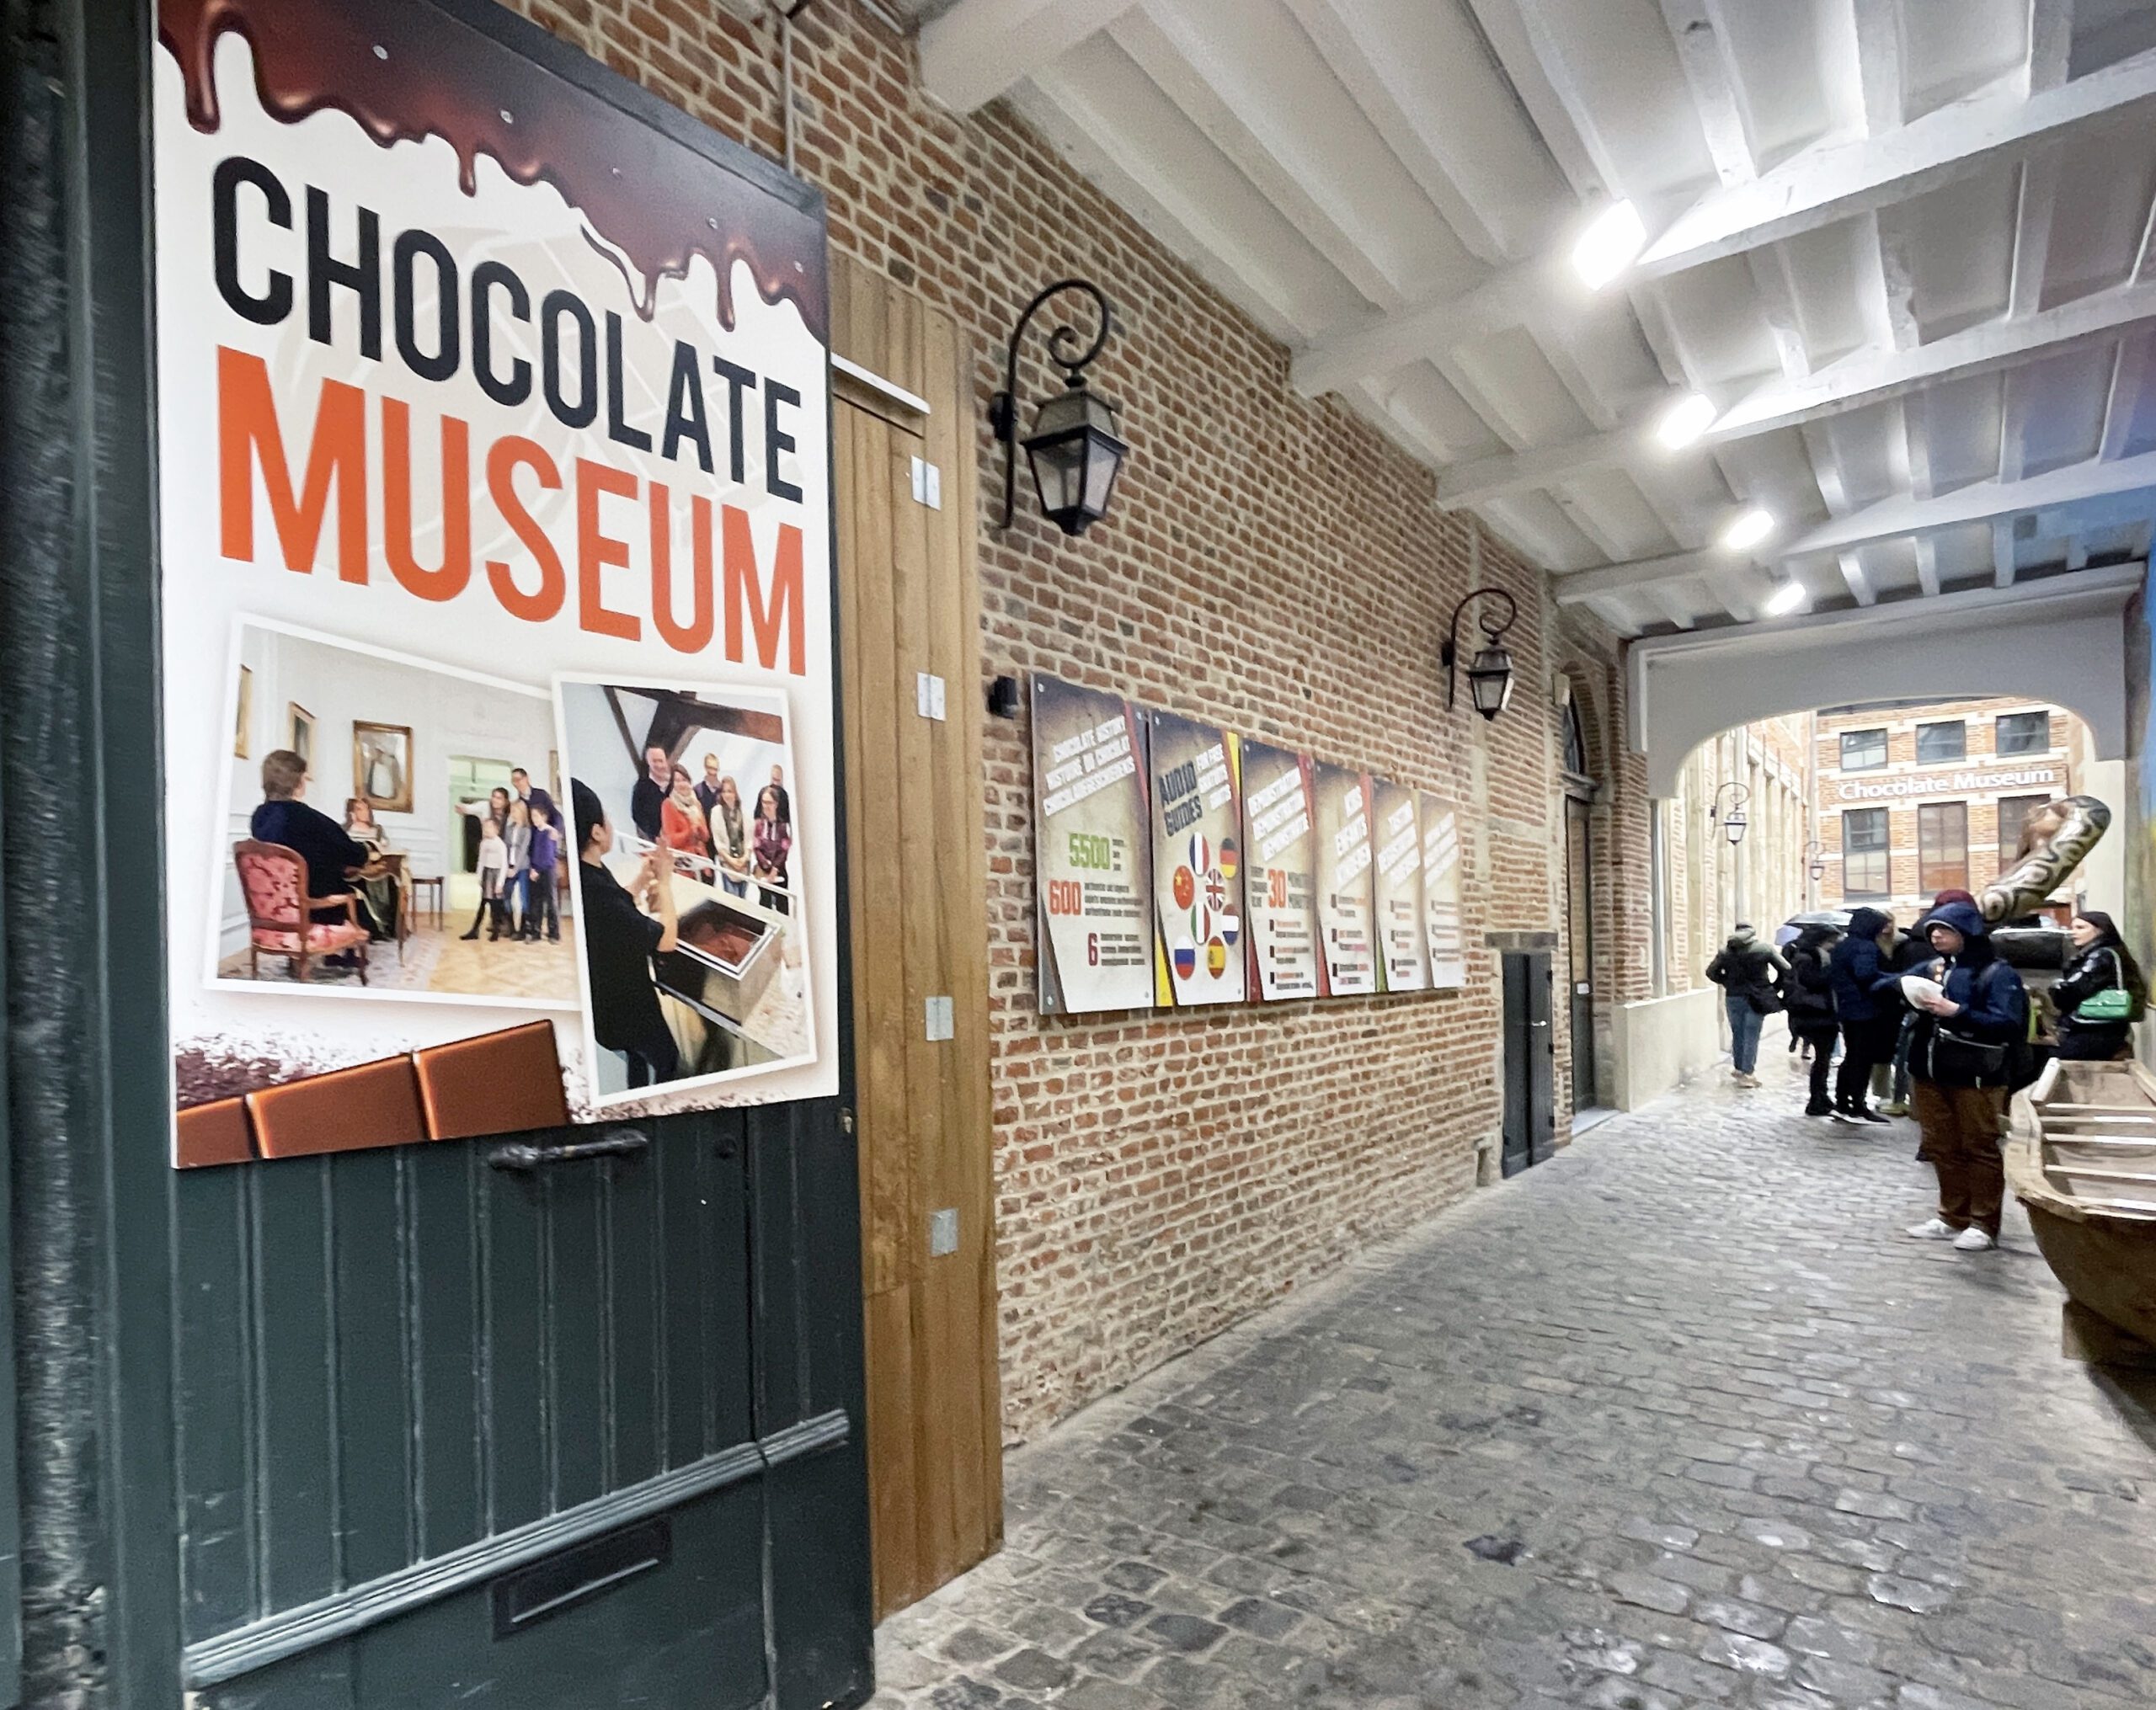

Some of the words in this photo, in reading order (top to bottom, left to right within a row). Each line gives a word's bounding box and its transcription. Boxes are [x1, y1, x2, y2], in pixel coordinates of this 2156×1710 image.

[212, 155, 803, 505] CHOCOLATE
[216, 344, 806, 676] MUSEUM
[1159, 759, 1196, 807] AUDIO
[1838, 776, 1948, 800] Chocolate
[1953, 769, 2054, 790] Museum
[1164, 795, 1203, 837] GUIDES
[1069, 833, 1111, 870] 5500
[1049, 879, 1082, 916] 600
[1267, 868, 1287, 908] 30
[1087, 932, 1098, 967] 6
